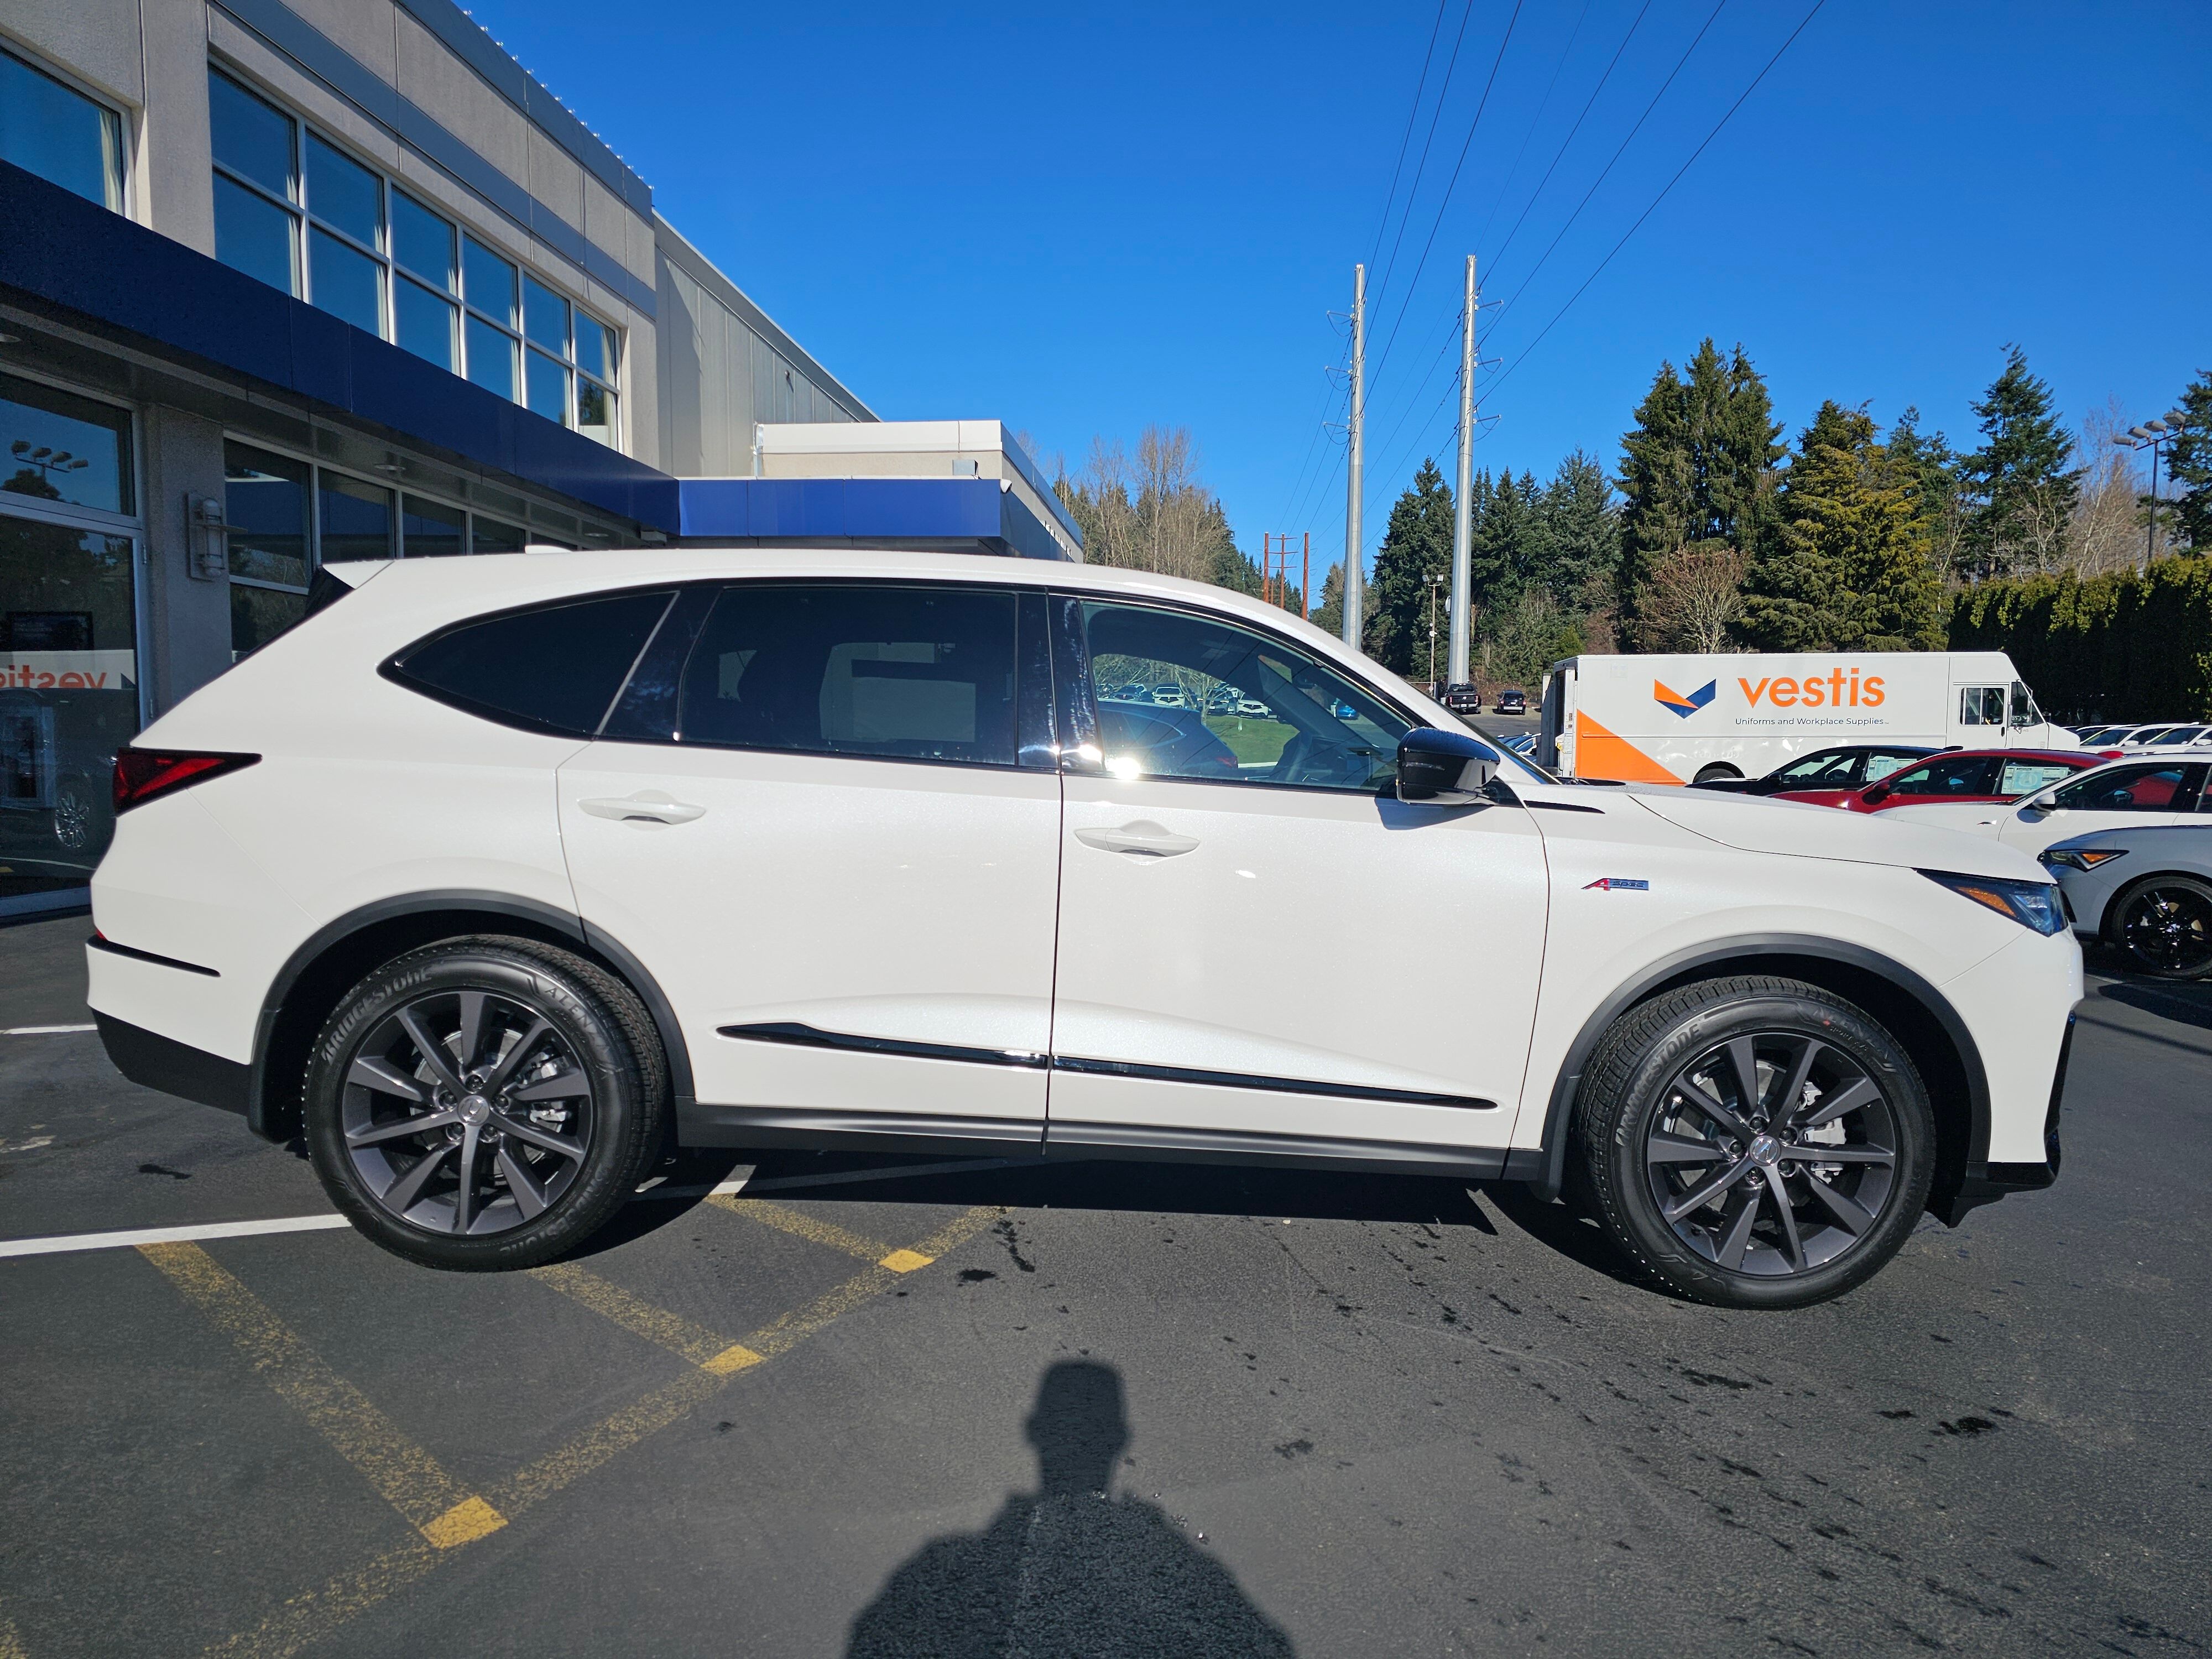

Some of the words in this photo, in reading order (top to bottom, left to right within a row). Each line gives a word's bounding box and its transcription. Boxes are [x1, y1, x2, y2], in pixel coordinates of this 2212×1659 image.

[1738, 667, 1885, 708] vestis
[1797, 718, 1844, 726] Workplace
[1846, 717, 1884, 726] Supplies
